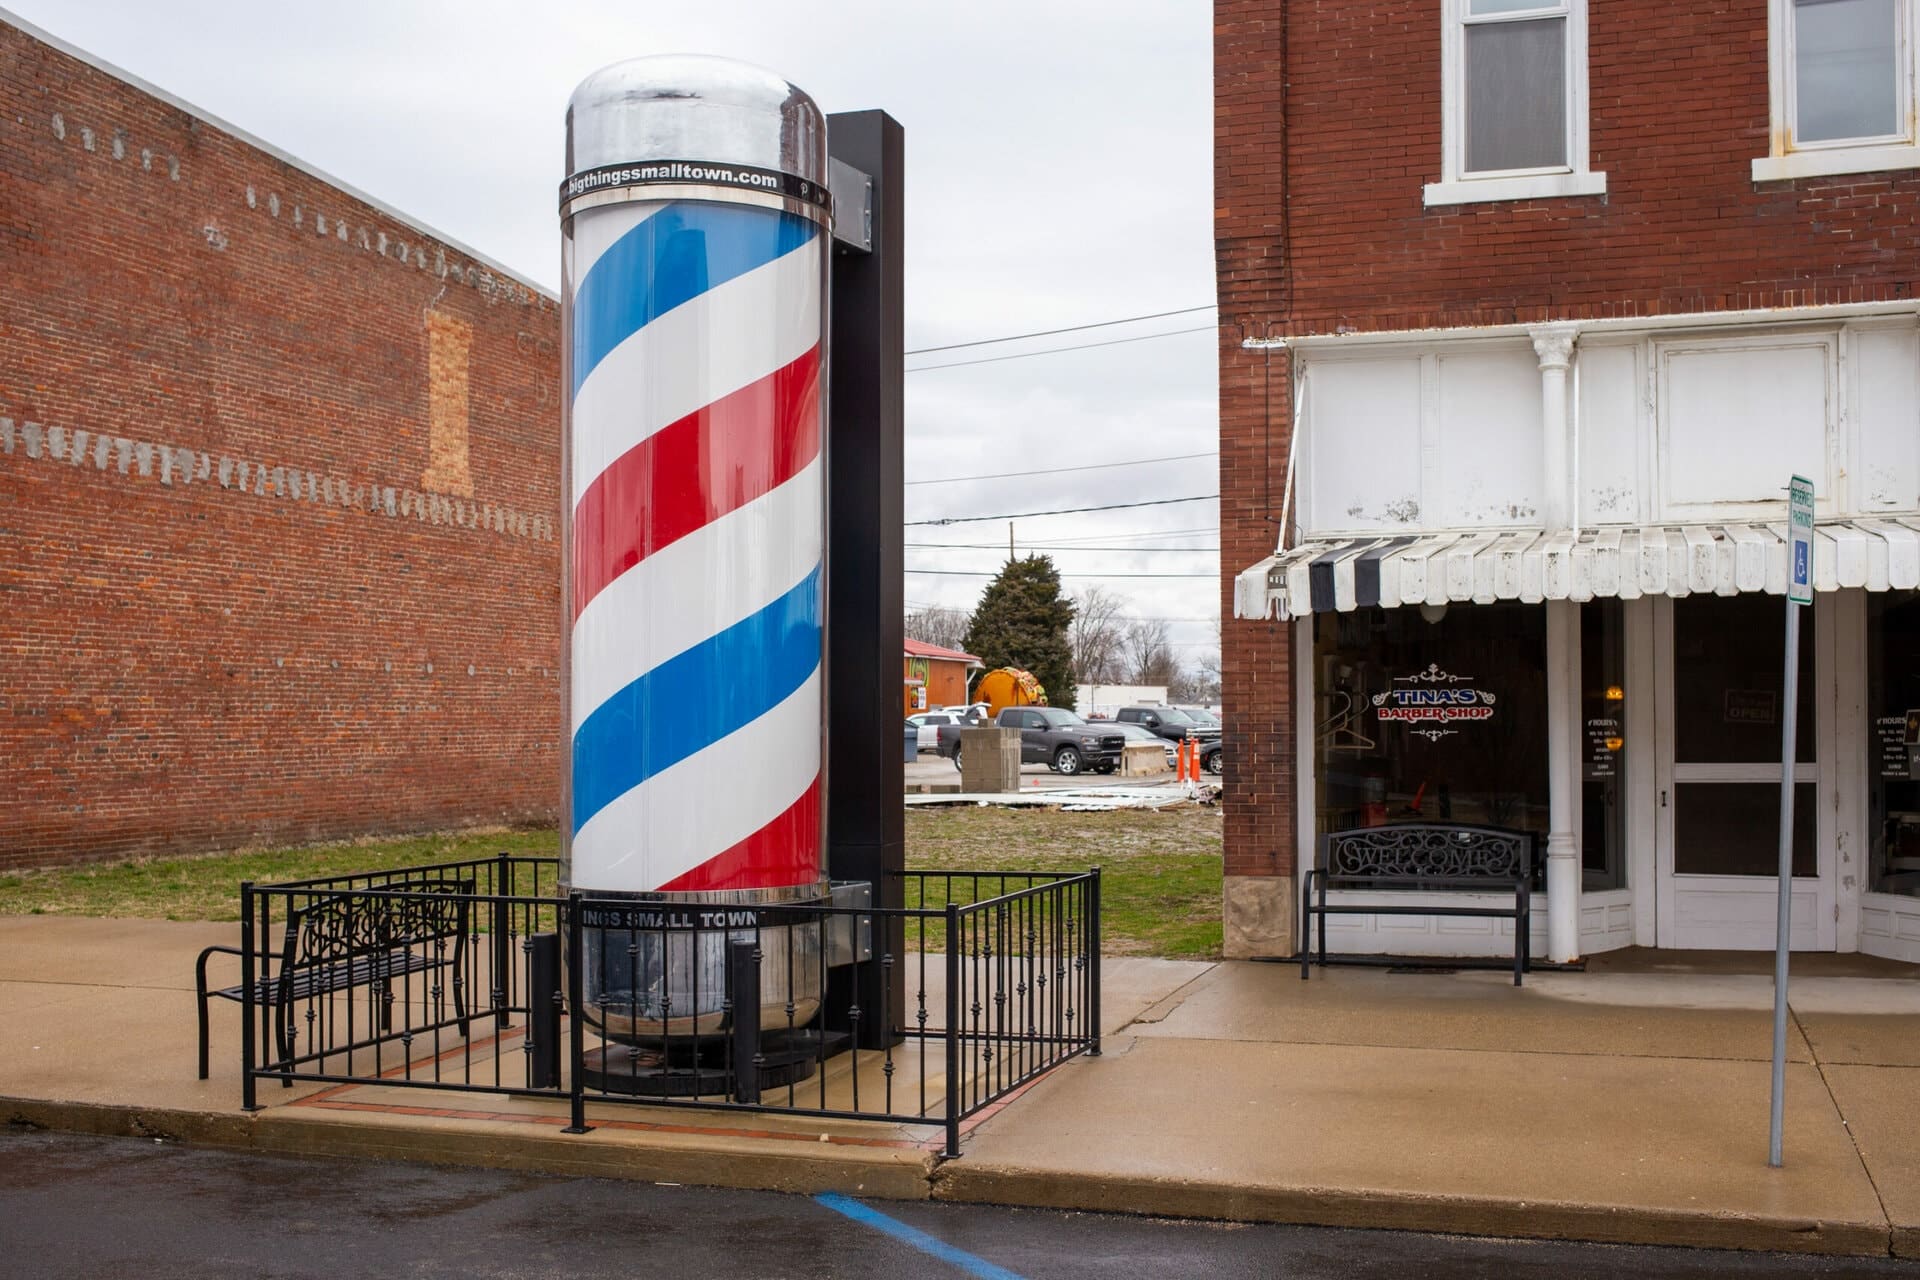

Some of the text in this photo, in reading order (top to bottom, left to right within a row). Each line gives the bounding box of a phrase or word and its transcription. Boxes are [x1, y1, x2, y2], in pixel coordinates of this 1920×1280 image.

[568, 163, 777, 195] bigthingssmalltown.com
[1393, 688, 1478, 705] TINA'S
[1377, 706, 1494, 724] BARBER SHOP
[1355, 847, 1490, 867] WELCOME
[583, 910, 757, 928] INGS SMALL TOWN
